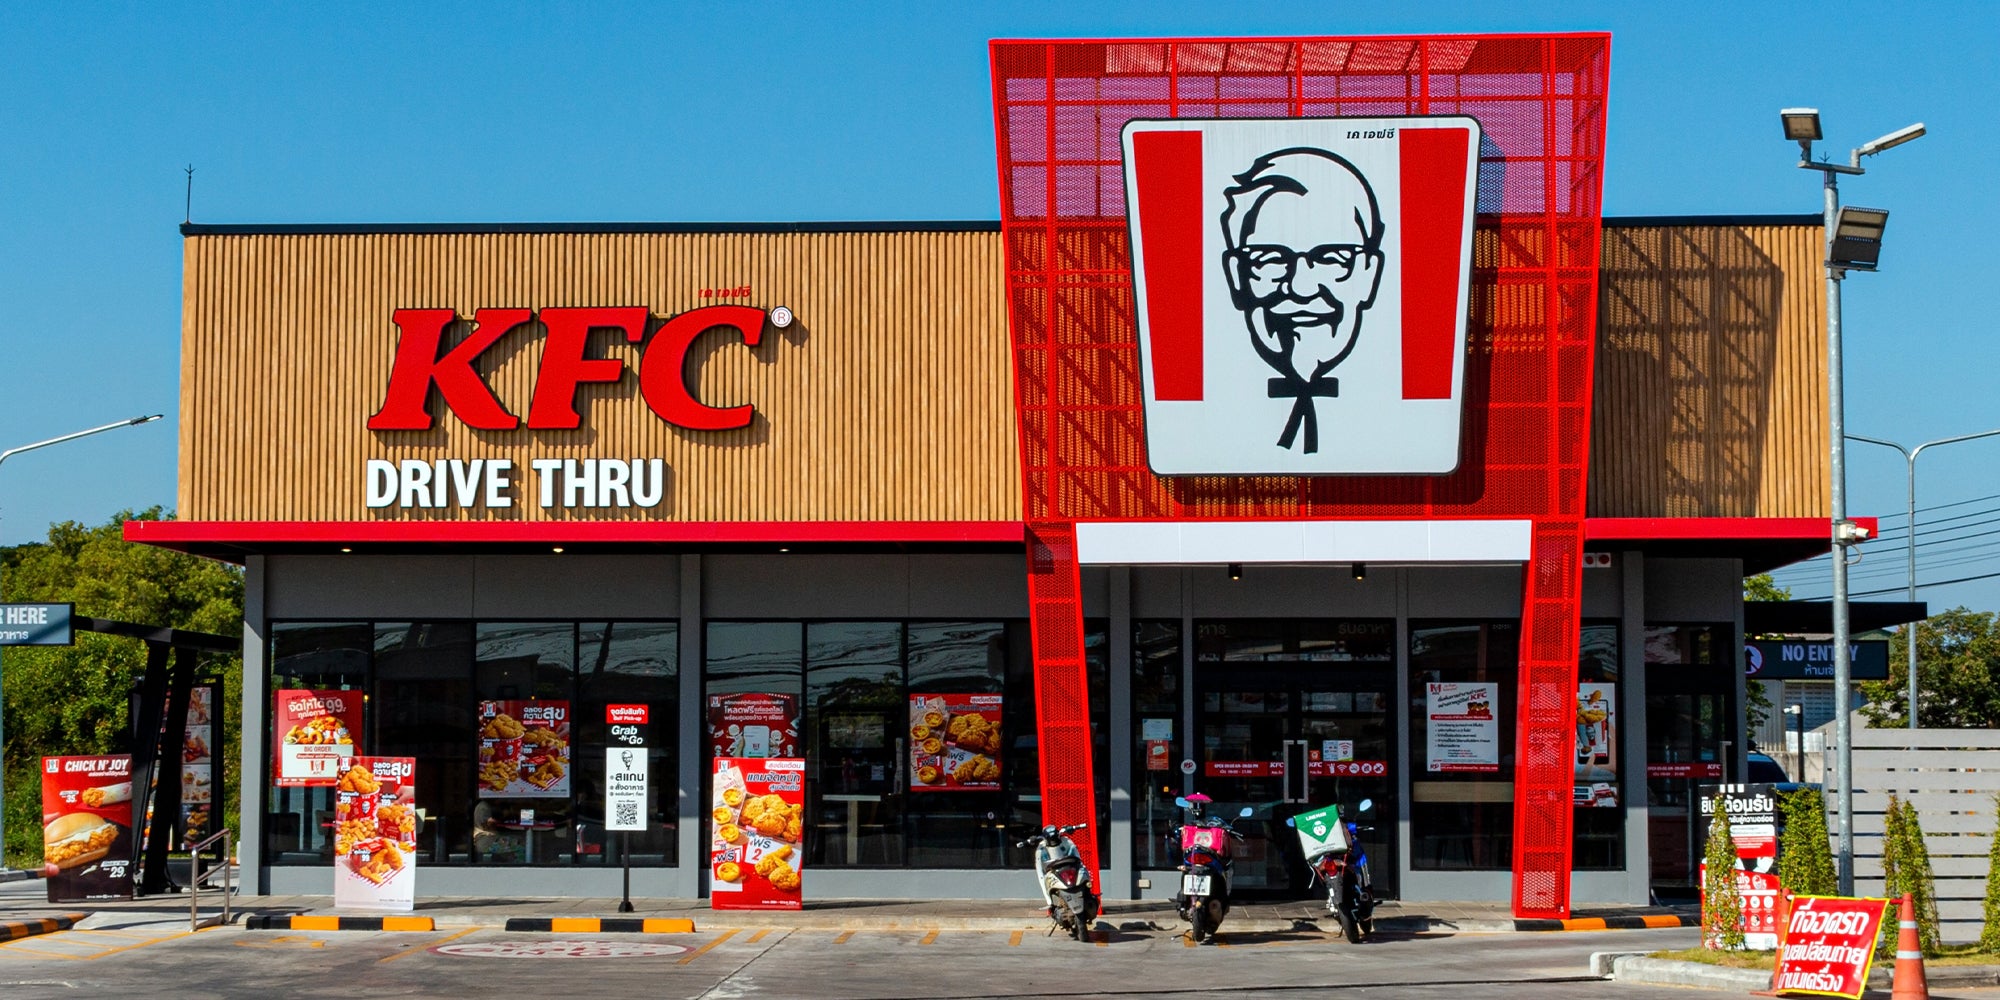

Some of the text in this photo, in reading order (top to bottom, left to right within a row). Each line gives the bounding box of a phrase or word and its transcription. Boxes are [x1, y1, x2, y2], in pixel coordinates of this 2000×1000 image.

[367, 305, 766, 432] KFC
[366, 458, 664, 509] DRIVE THRU
[7, 607, 48, 625] HERE
[1782, 645, 1804, 661] NO
[611, 725, 638, 736] Grab
[629, 735, 644, 745] Go
[65, 761, 96, 772] CHICK
[108, 759, 129, 770] JOY
[391, 762, 412, 784] สุข
[615, 773, 645, 782] สแกน
[752, 848, 762, 861] 2
